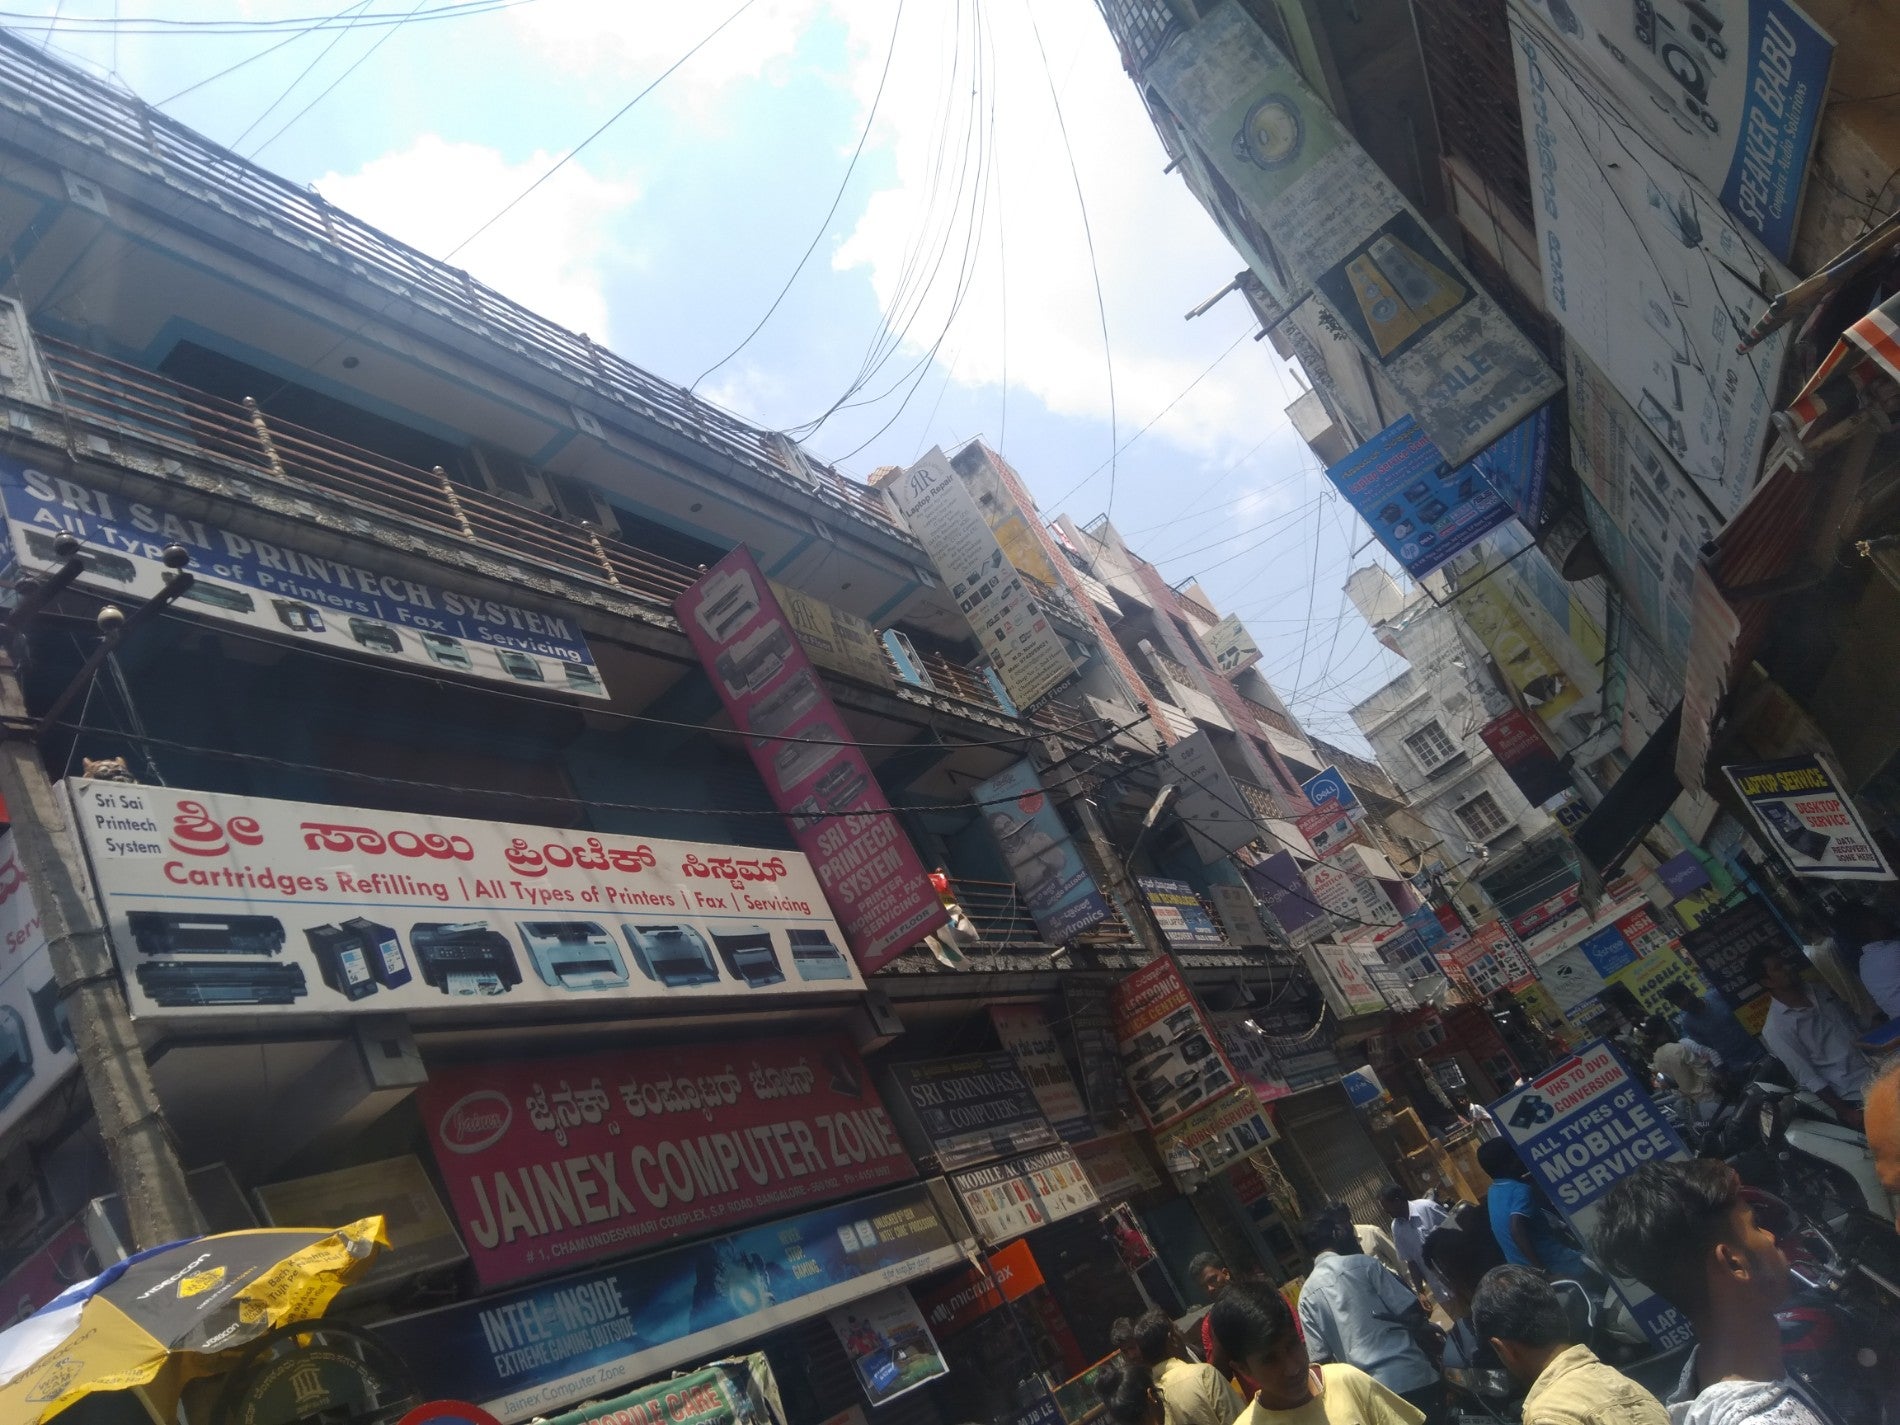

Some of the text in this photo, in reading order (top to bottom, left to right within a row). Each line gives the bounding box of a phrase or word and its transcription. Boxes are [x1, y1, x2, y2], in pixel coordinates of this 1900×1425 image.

[1738, 10, 1798, 232] SPEAKER BABU
[1769, 82, 1809, 219] Complete Audio Solutions
[905, 474, 955, 519] Laptop Repair
[23, 468, 573, 642] SRI SAI PRINTECH SYSTEM
[33, 507, 582, 663] All Typs of Printers Fax Servicing
[1028, 695, 1048, 714] 2nd
[1047, 680, 1072, 698] Floor
[94, 793, 145, 811] Sri Sai
[1314, 785, 1338, 803] DELL
[1738, 768, 1829, 796] LAPTOP SERVICE
[96, 814, 157, 832] Printech
[816, 800, 876, 856] SRI SAI
[1794, 799, 1842, 815] DESKTOP
[1806, 813, 1850, 829] SERVICE
[105, 838, 162, 856] System
[167, 800, 264, 857] ಶ್ರೀ
[301, 821, 475, 861] ಸಾಯಿ
[1835, 837, 1856, 846] DATA
[817, 818, 898, 888] PRINTECH
[164, 860, 812, 917] Cartridges Refilling All Types of Printers Fax Servicing
[838, 848, 904, 905] SYSTEM
[858, 875, 904, 915] PRINTER
[849, 874, 926, 936] MONITOR FAX
[863, 892, 921, 938] SERVICING
[897, 907, 931, 937] FLOOR
[1049, 909, 1105, 941] Skytronics
[1638, 961, 1681, 999] MOBILE
[1146, 989, 1188, 1020] CENTRE
[910, 1071, 1026, 1108] SRI SRINIVASA
[1545, 1054, 1610, 1099] VHS TO DVD
[1553, 1066, 1623, 1114] CONVERSION
[949, 1099, 1022, 1129] COMPUTERS
[1215, 1099, 1258, 1129] SERVICE
[1530, 1088, 1638, 1162] ALL TYPES OF
[1540, 1104, 1656, 1185] MOBILE
[1558, 1128, 1672, 1205] SERVICE
[471, 1151, 635, 1250] JAINEX
[631, 1117, 820, 1210] COMPUTER
[817, 1106, 903, 1169] ZONE
[956, 1148, 1072, 1192] MOBILE ACCESSORIES
[551, 1219, 658, 1261] CHAMUNDESHWARI
[658, 1207, 709, 1232] COMPLEX,
[727, 1195, 757, 1215] ROAD,
[756, 1186, 808, 1210] BANGALORE
[266, 1266, 291, 1288] Bach
[266, 1281, 291, 1302] Tujh
[791, 1257, 822, 1282] GAMING.
[479, 1276, 630, 1357] INTEL INSIDE
[494, 1315, 638, 1378] EXTREME GAMING OUTSIDE
[502, 1361, 628, 1417] Jainex Computer Zone
[667, 1383, 724, 1423] CARE
